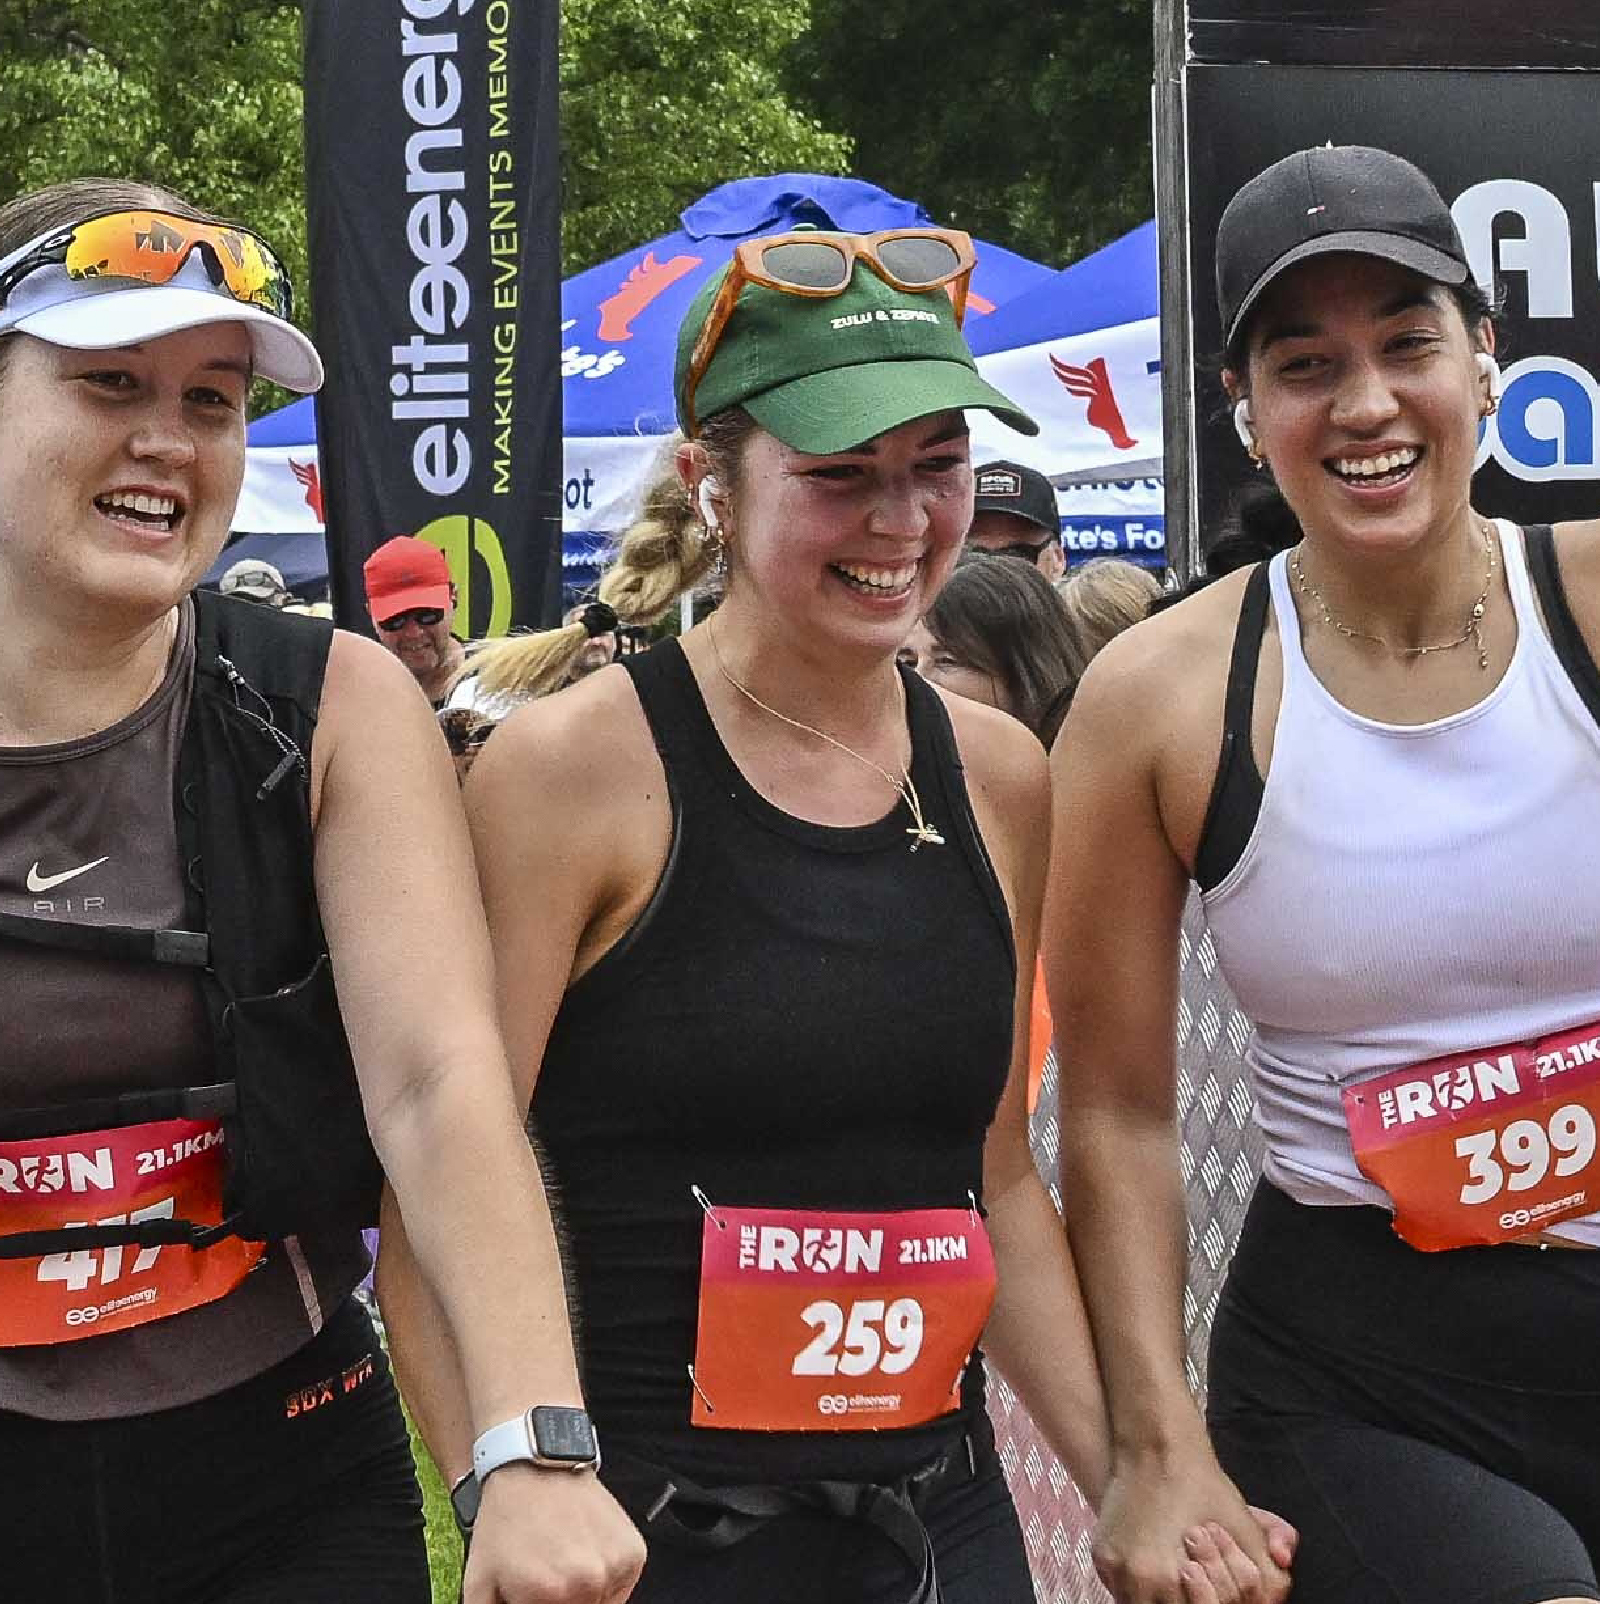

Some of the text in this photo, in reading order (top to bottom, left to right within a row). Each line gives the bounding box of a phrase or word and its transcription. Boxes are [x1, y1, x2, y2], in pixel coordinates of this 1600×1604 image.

[485, 0, 518, 494] MAKING EVENTS MEMO
[830, 311, 873, 329] ZULU
[875, 310, 890, 321] &
[1379, 1089, 1399, 1130] THE
[1394, 1053, 1521, 1125] RUN
[135, 1126, 226, 1176] 21.1KM
[1454, 1103, 1597, 1206] 399
[36, 1197, 175, 1291] 417
[738, 1224, 969, 1274] THE RUN 21.1KM
[791, 1297, 925, 1377] 259
